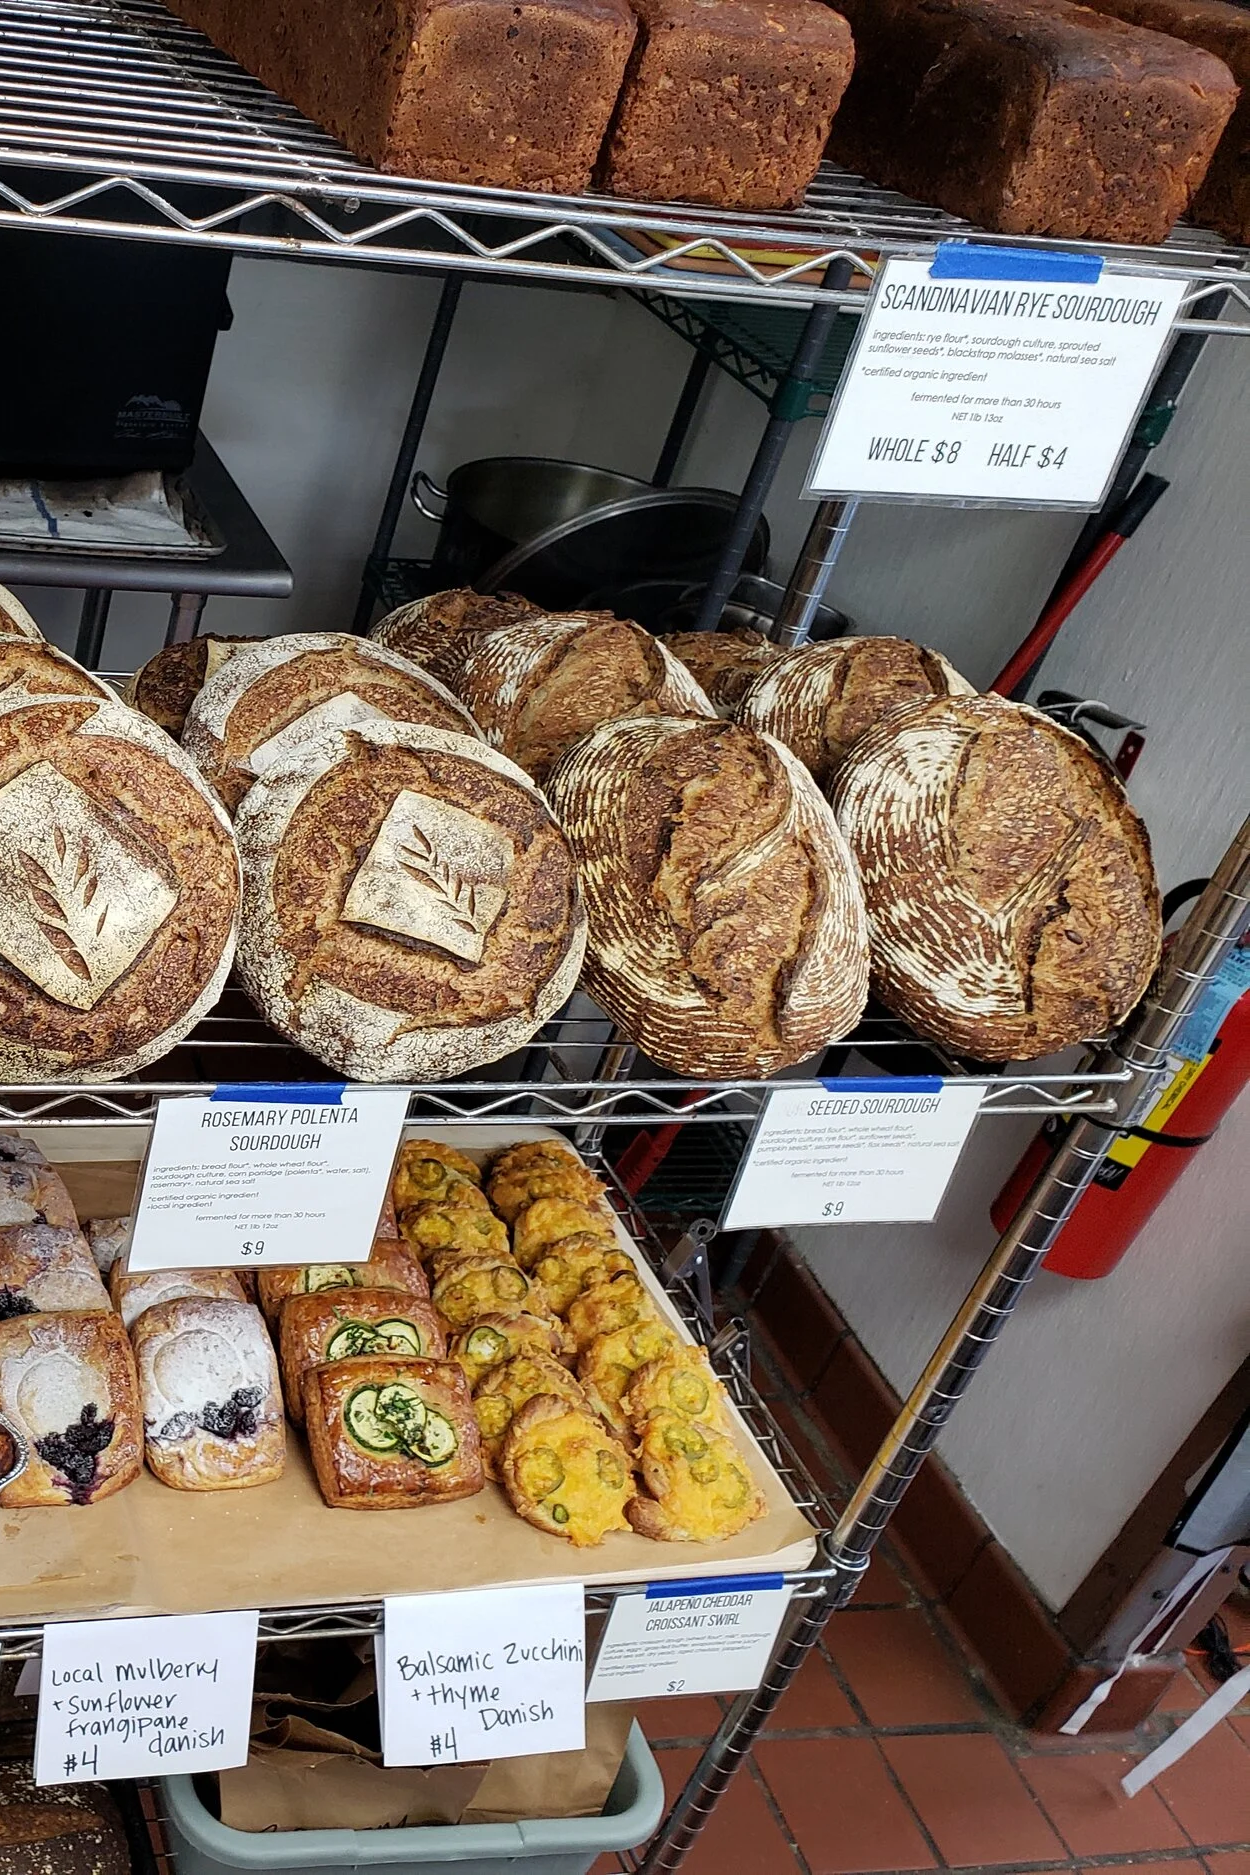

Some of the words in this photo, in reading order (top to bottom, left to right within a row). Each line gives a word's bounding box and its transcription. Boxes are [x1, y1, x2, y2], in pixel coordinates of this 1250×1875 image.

[880, 283, 1016, 316] SCANDINAVIAN
[1012, 291, 1055, 318] RYE
[1051, 293, 1163, 326] SOURDOUGH
[871, 328, 927, 342] ingredients:
[925, 333, 943, 344] rye
[970, 334, 1022, 349] sourdough
[1057, 340, 1102, 352] sprouted
[866, 342, 913, 355] sunflower
[946, 345, 997, 361] blackstrap
[1044, 352, 1081, 364] natural
[1078, 355, 1099, 366] sea
[1097, 355, 1117, 367] salt
[902, 368, 940, 381] organic
[939, 368, 989, 383] ingredient
[910, 390, 961, 404] fermented
[959, 393, 975, 405] for
[973, 396, 1000, 406] more
[1000, 395, 1023, 407] than
[1022, 396, 1037, 408] 30
[1035, 397, 1062, 410] hours
[950, 411, 970, 421] NET
[968, 411, 983, 422] 1lb
[983, 412, 1004, 424] 13oz
[867, 436, 930, 462] WHOLE
[930, 439, 962, 464] $8
[986, 442, 1036, 468] HALF
[1036, 444, 1068, 470] $4
[806, 1098, 860, 1116] SEEDED
[859, 1096, 941, 1114] SOURDOUGH
[200, 1108, 288, 1128] ROSEMARY
[289, 1107, 358, 1125] POLENTA
[229, 1133, 322, 1151] SOURDOUGH
[821, 1200, 844, 1217] $9
[240, 1239, 265, 1256] $9
[645, 1595, 702, 1613] JALAPEÑO
[701, 1592, 754, 1609] CHEDDAR
[645, 1614, 708, 1631] CROISSANT
[706, 1611, 740, 1627] SWIRL
[53, 1662, 103, 1686] Local
[397, 1651, 494, 1680] Balsamic
[665, 1678, 686, 1693] $2
[427, 1683, 500, 1710] thyme
[479, 1700, 553, 1731] Danish
[66, 1716, 188, 1743] frangipane
[149, 1727, 224, 1757] danish
